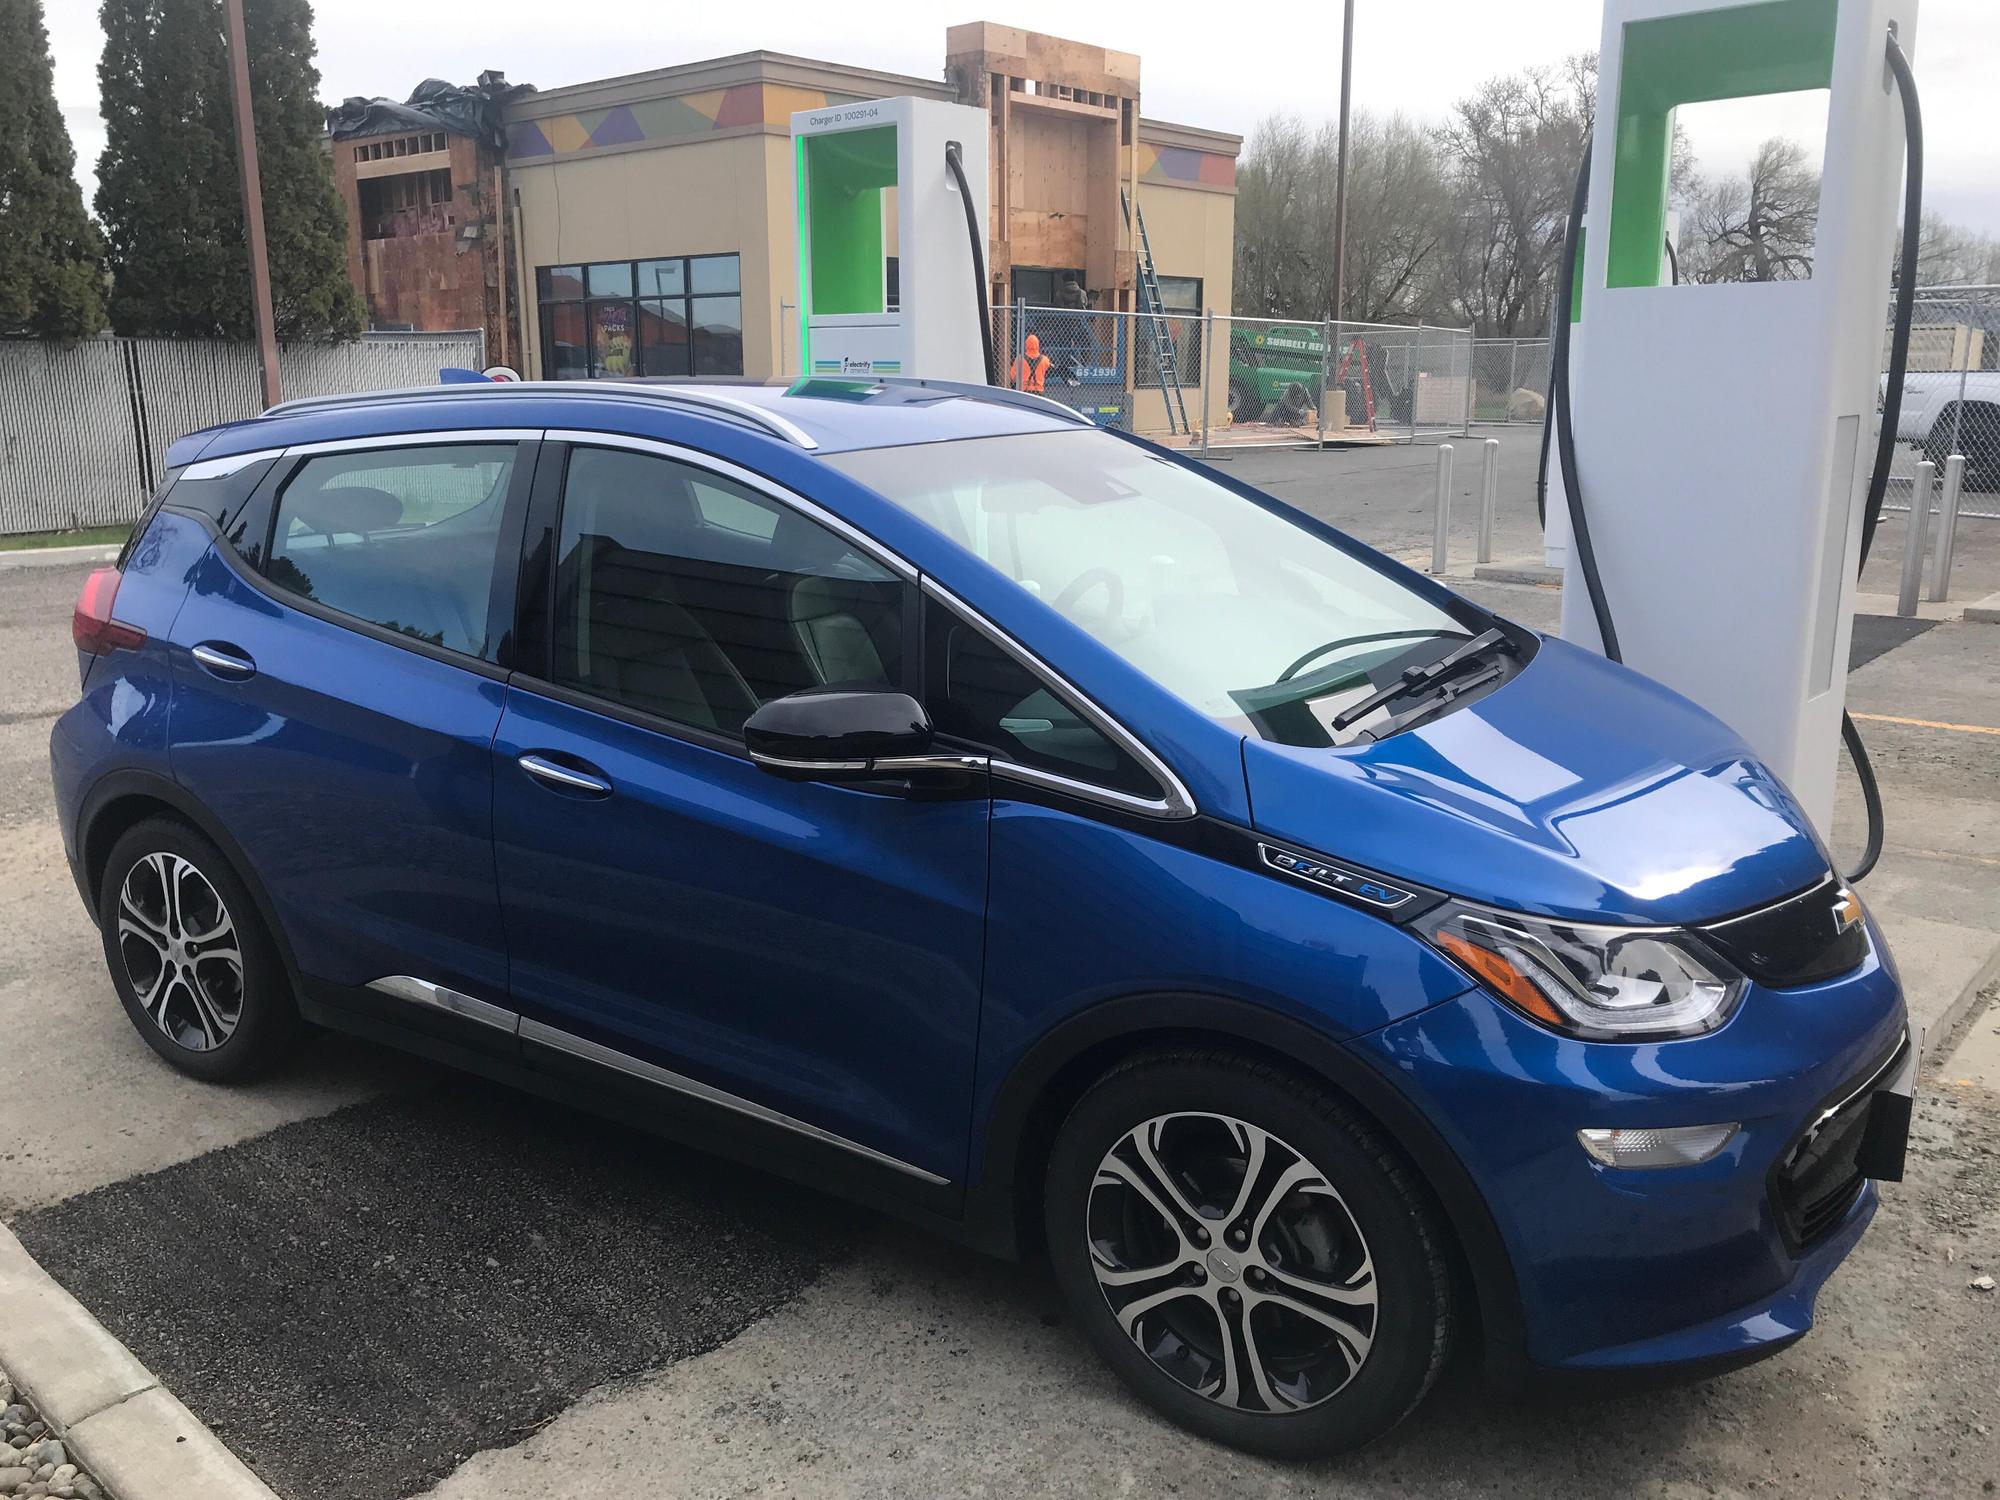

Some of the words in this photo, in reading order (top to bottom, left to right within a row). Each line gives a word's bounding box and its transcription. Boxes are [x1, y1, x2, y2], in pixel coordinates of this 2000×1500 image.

[809, 116, 834, 126] Charger
[834, 113, 842, 122] ID
[844, 108, 878, 121] 100291-04
[1267, 337, 1307, 349] SUNBELT
[849, 361, 870, 369] electrify
[1076, 368, 1117, 377] GS-1930
[1273, 854, 1352, 884] BOLT
[1358, 883, 1399, 900] EV
